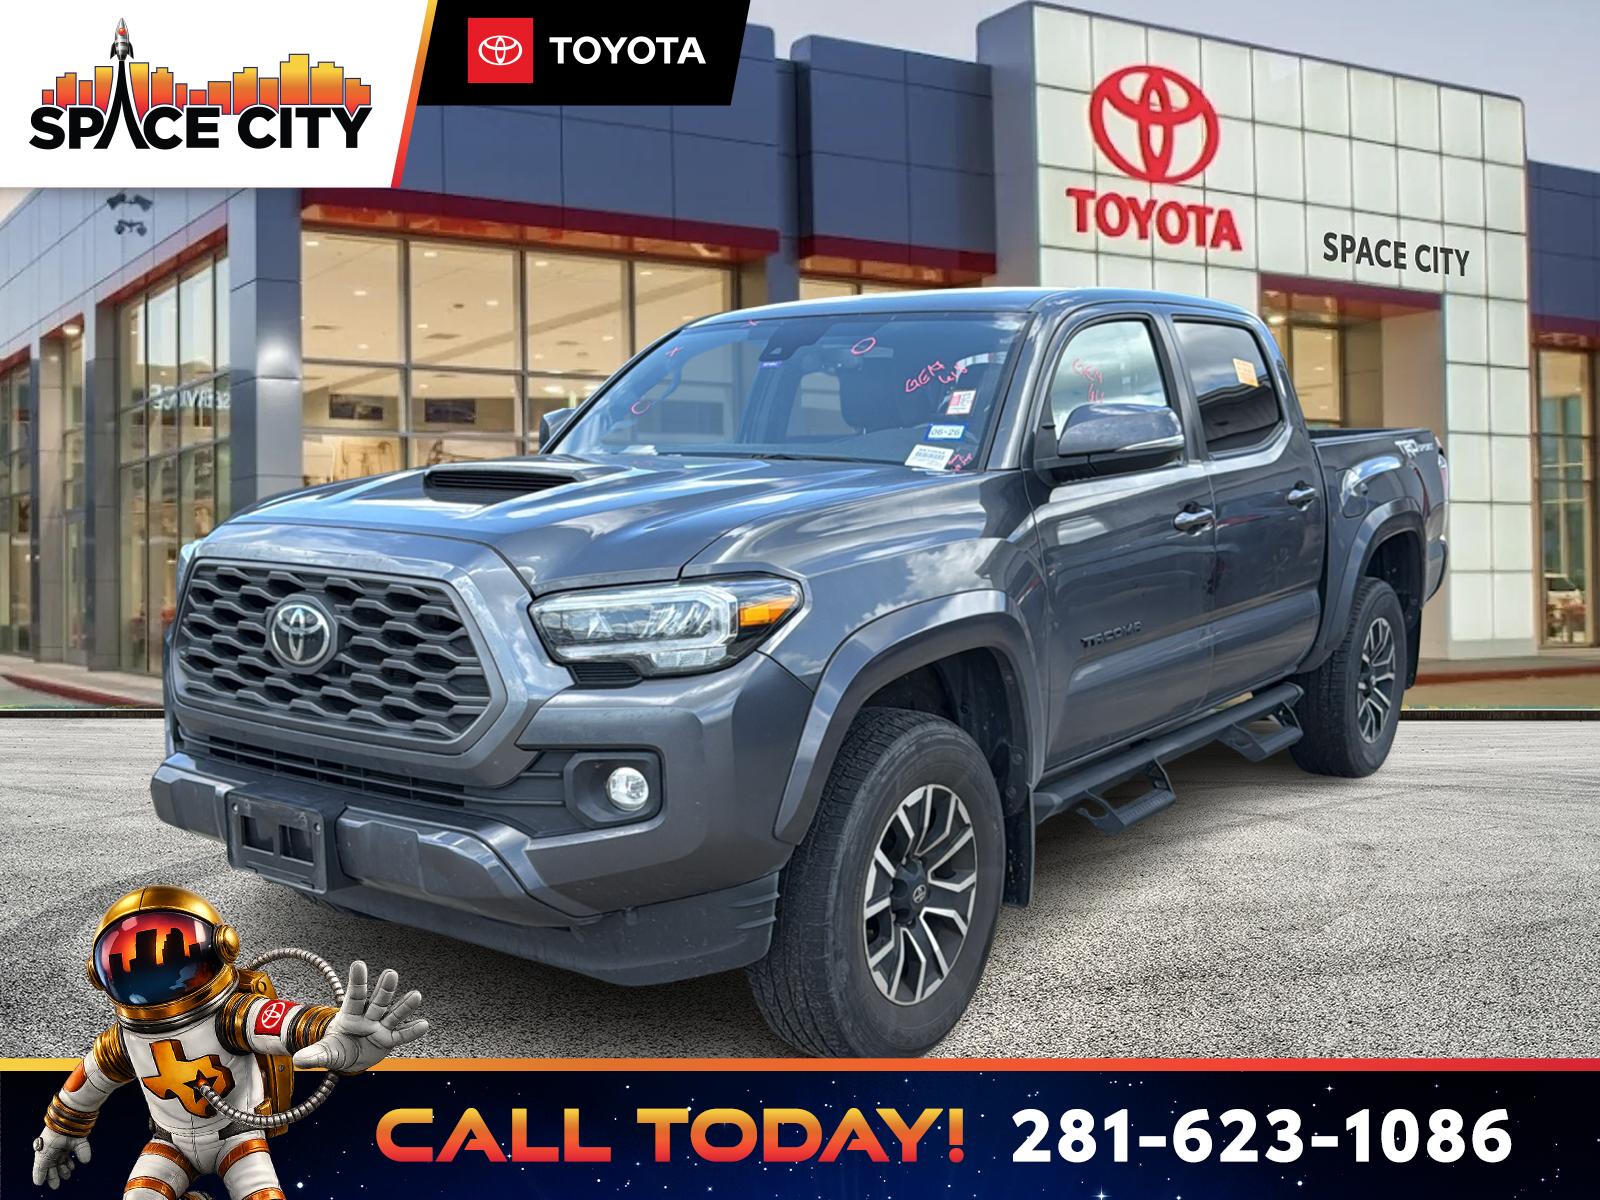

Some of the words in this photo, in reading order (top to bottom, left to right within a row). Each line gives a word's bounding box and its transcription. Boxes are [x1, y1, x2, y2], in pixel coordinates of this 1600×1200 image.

[1065, 186, 1243, 252] TOYOTA
[1322, 231, 1407, 270] SPACE
[1414, 243, 1471, 277] CITY
